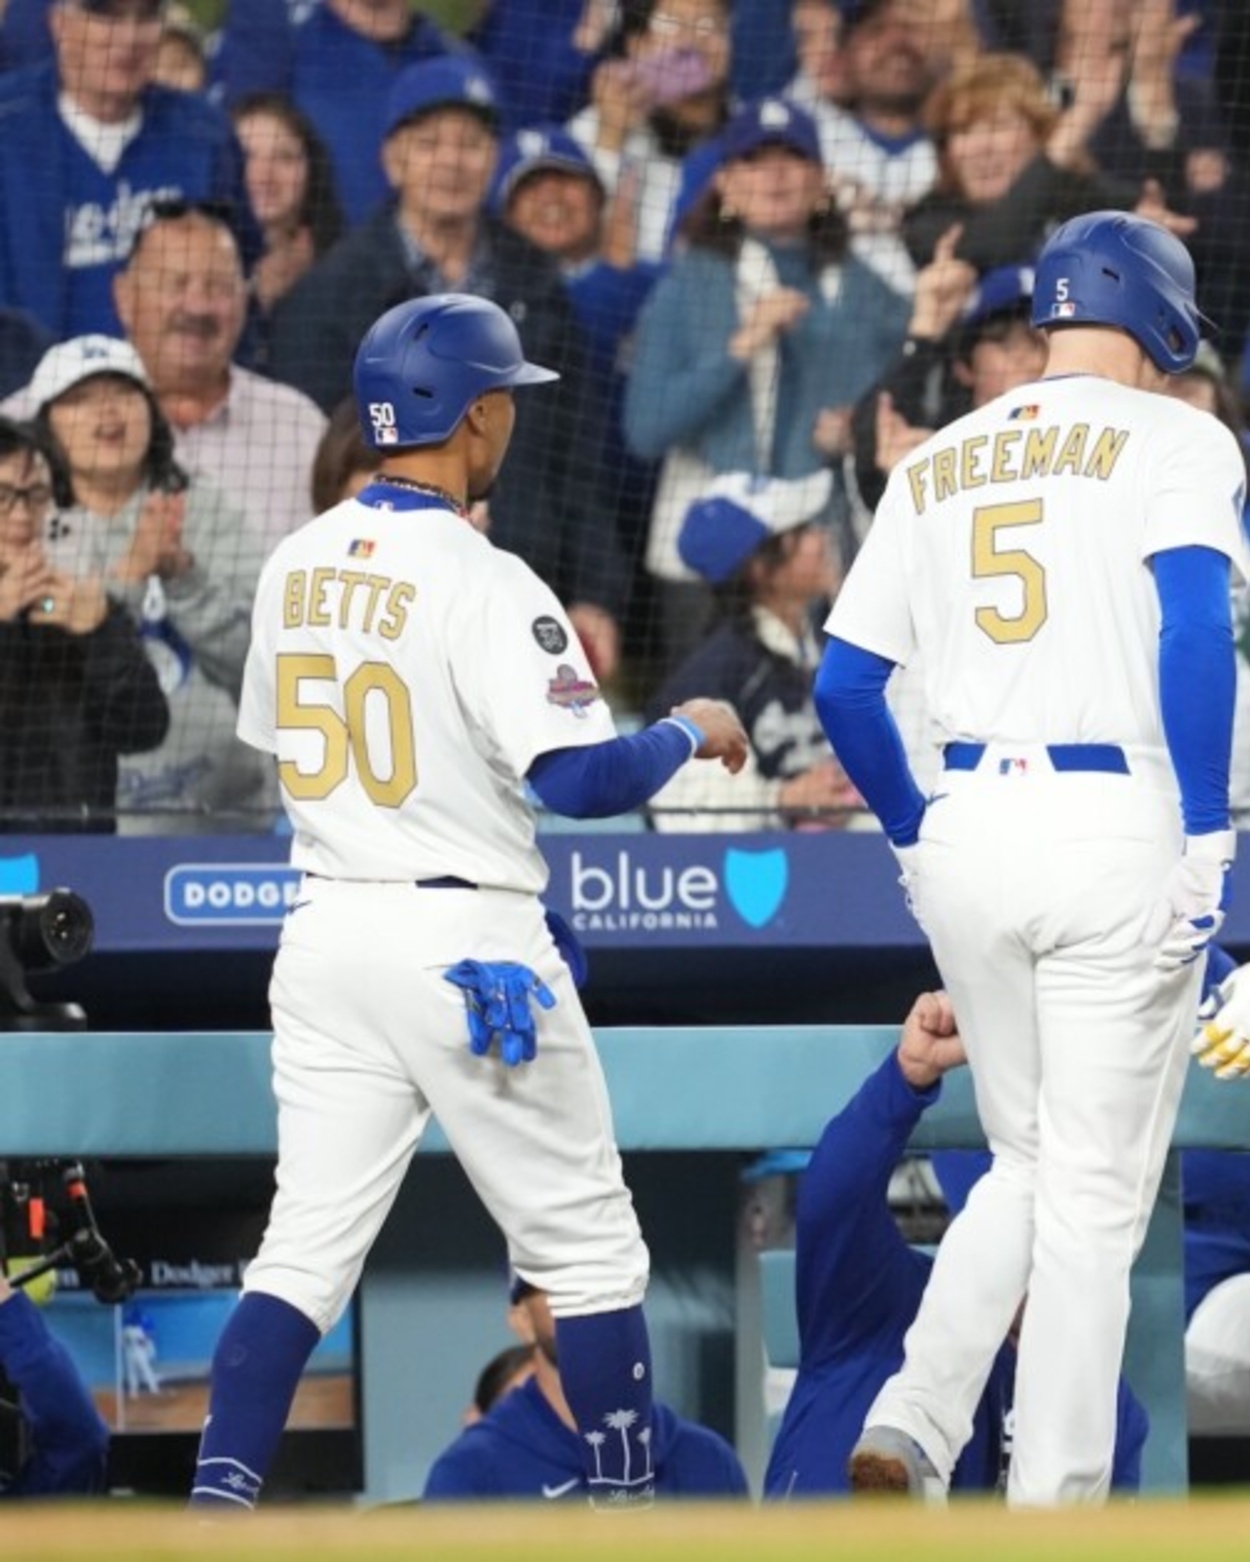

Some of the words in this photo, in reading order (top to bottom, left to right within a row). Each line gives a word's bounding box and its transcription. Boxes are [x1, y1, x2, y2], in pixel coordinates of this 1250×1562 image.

[1056, 277, 1069, 302] 5
[369, 402, 395, 428] 50
[907, 423, 1130, 516] FREEMAN
[972, 497, 1048, 645] 5
[284, 567, 416, 640] BETTS
[276, 652, 418, 809] 50
[571, 851, 718, 910] blue
[572, 912, 718, 931] CALIFORNIA
[151, 1258, 233, 1289] Dodger
